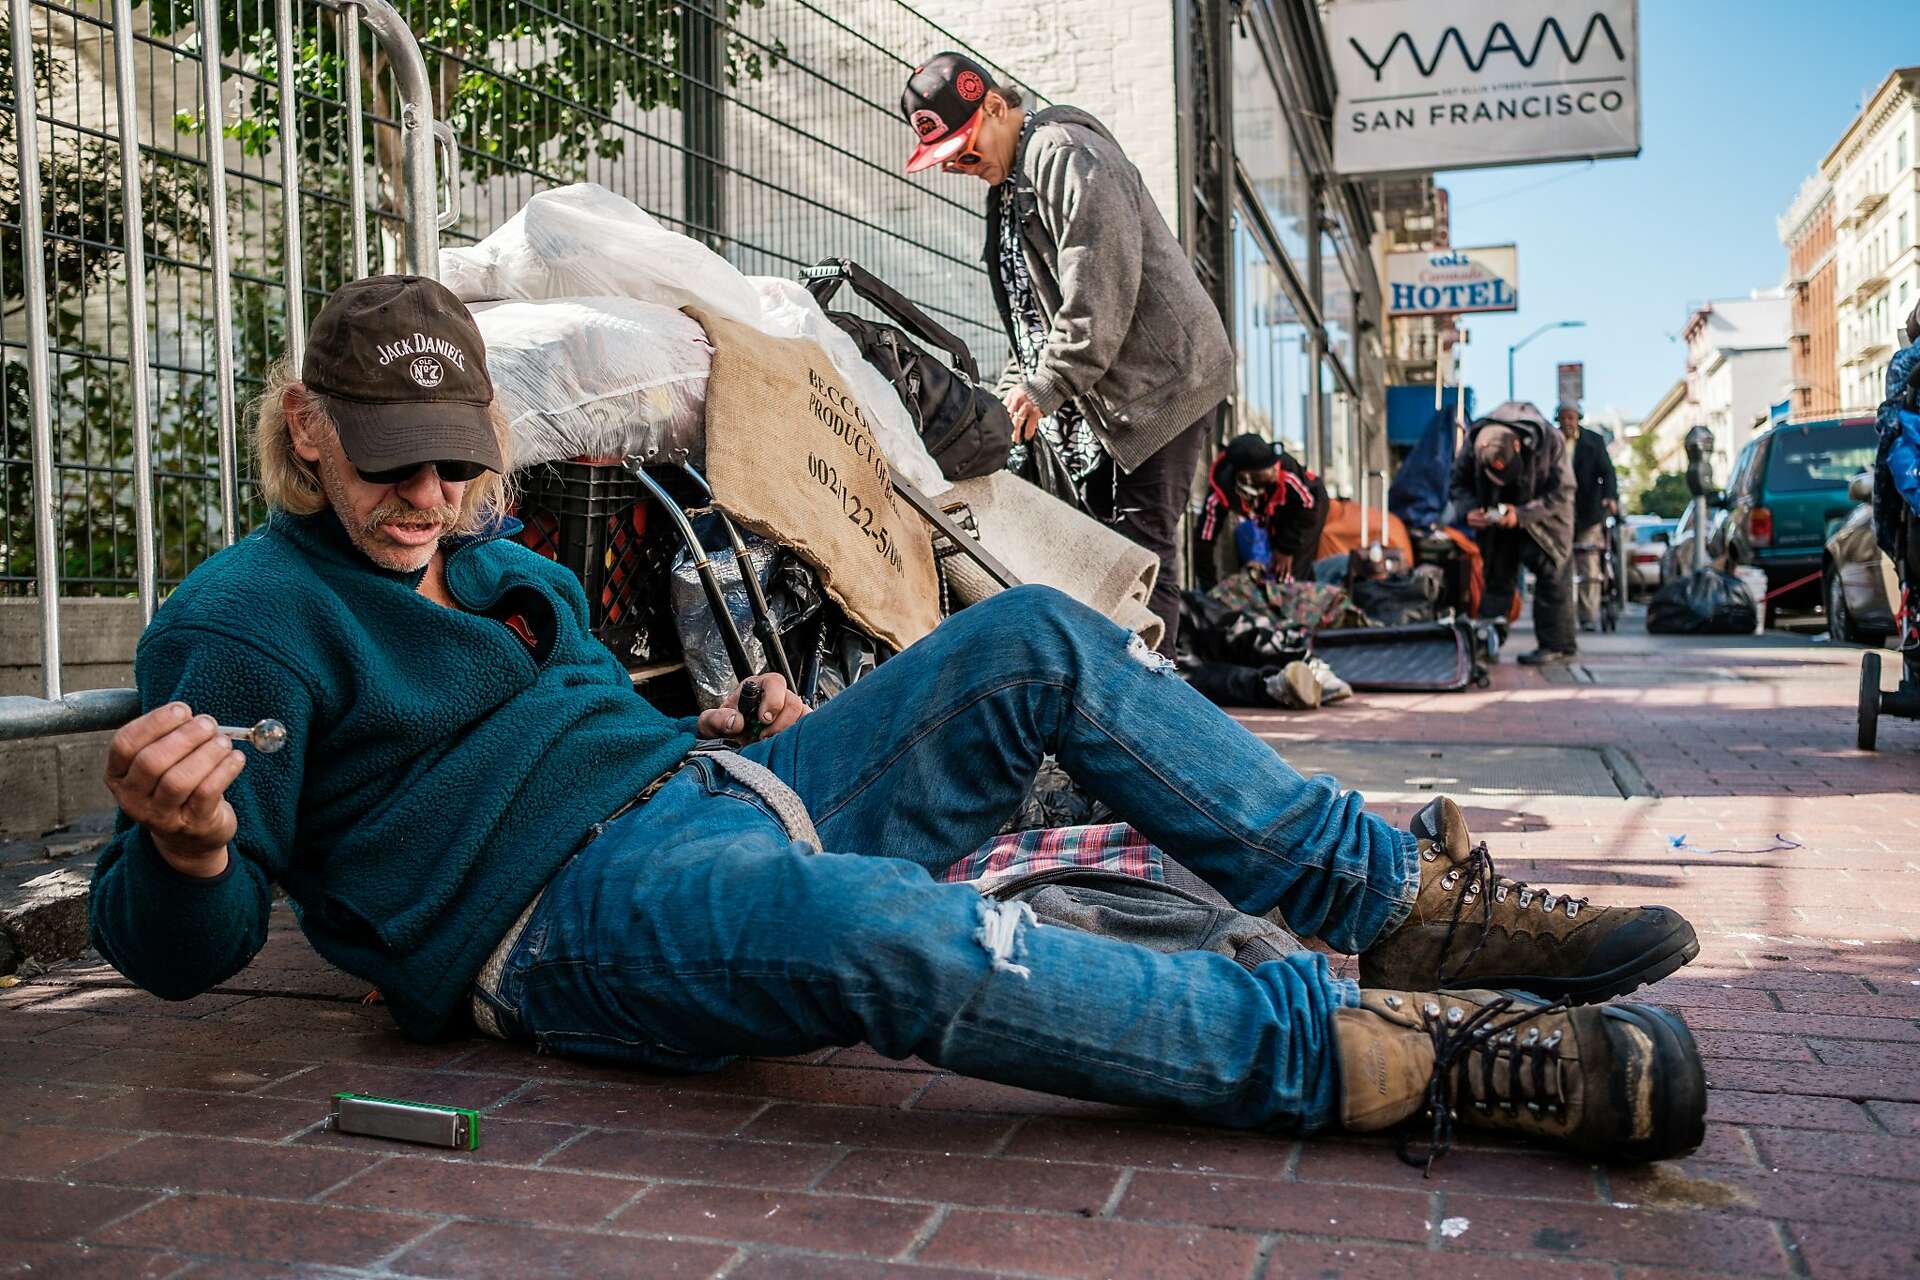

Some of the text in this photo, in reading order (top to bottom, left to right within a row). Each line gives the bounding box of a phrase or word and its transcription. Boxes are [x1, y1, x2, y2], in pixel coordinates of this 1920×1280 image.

[1352, 90, 1624, 133] SAN FRANCISCO
[1391, 278, 1514, 311] HOTEL
[376, 338, 415, 366] JACK
[809, 392, 876, 465] PRODUCT
[875, 457, 889, 486] OF
